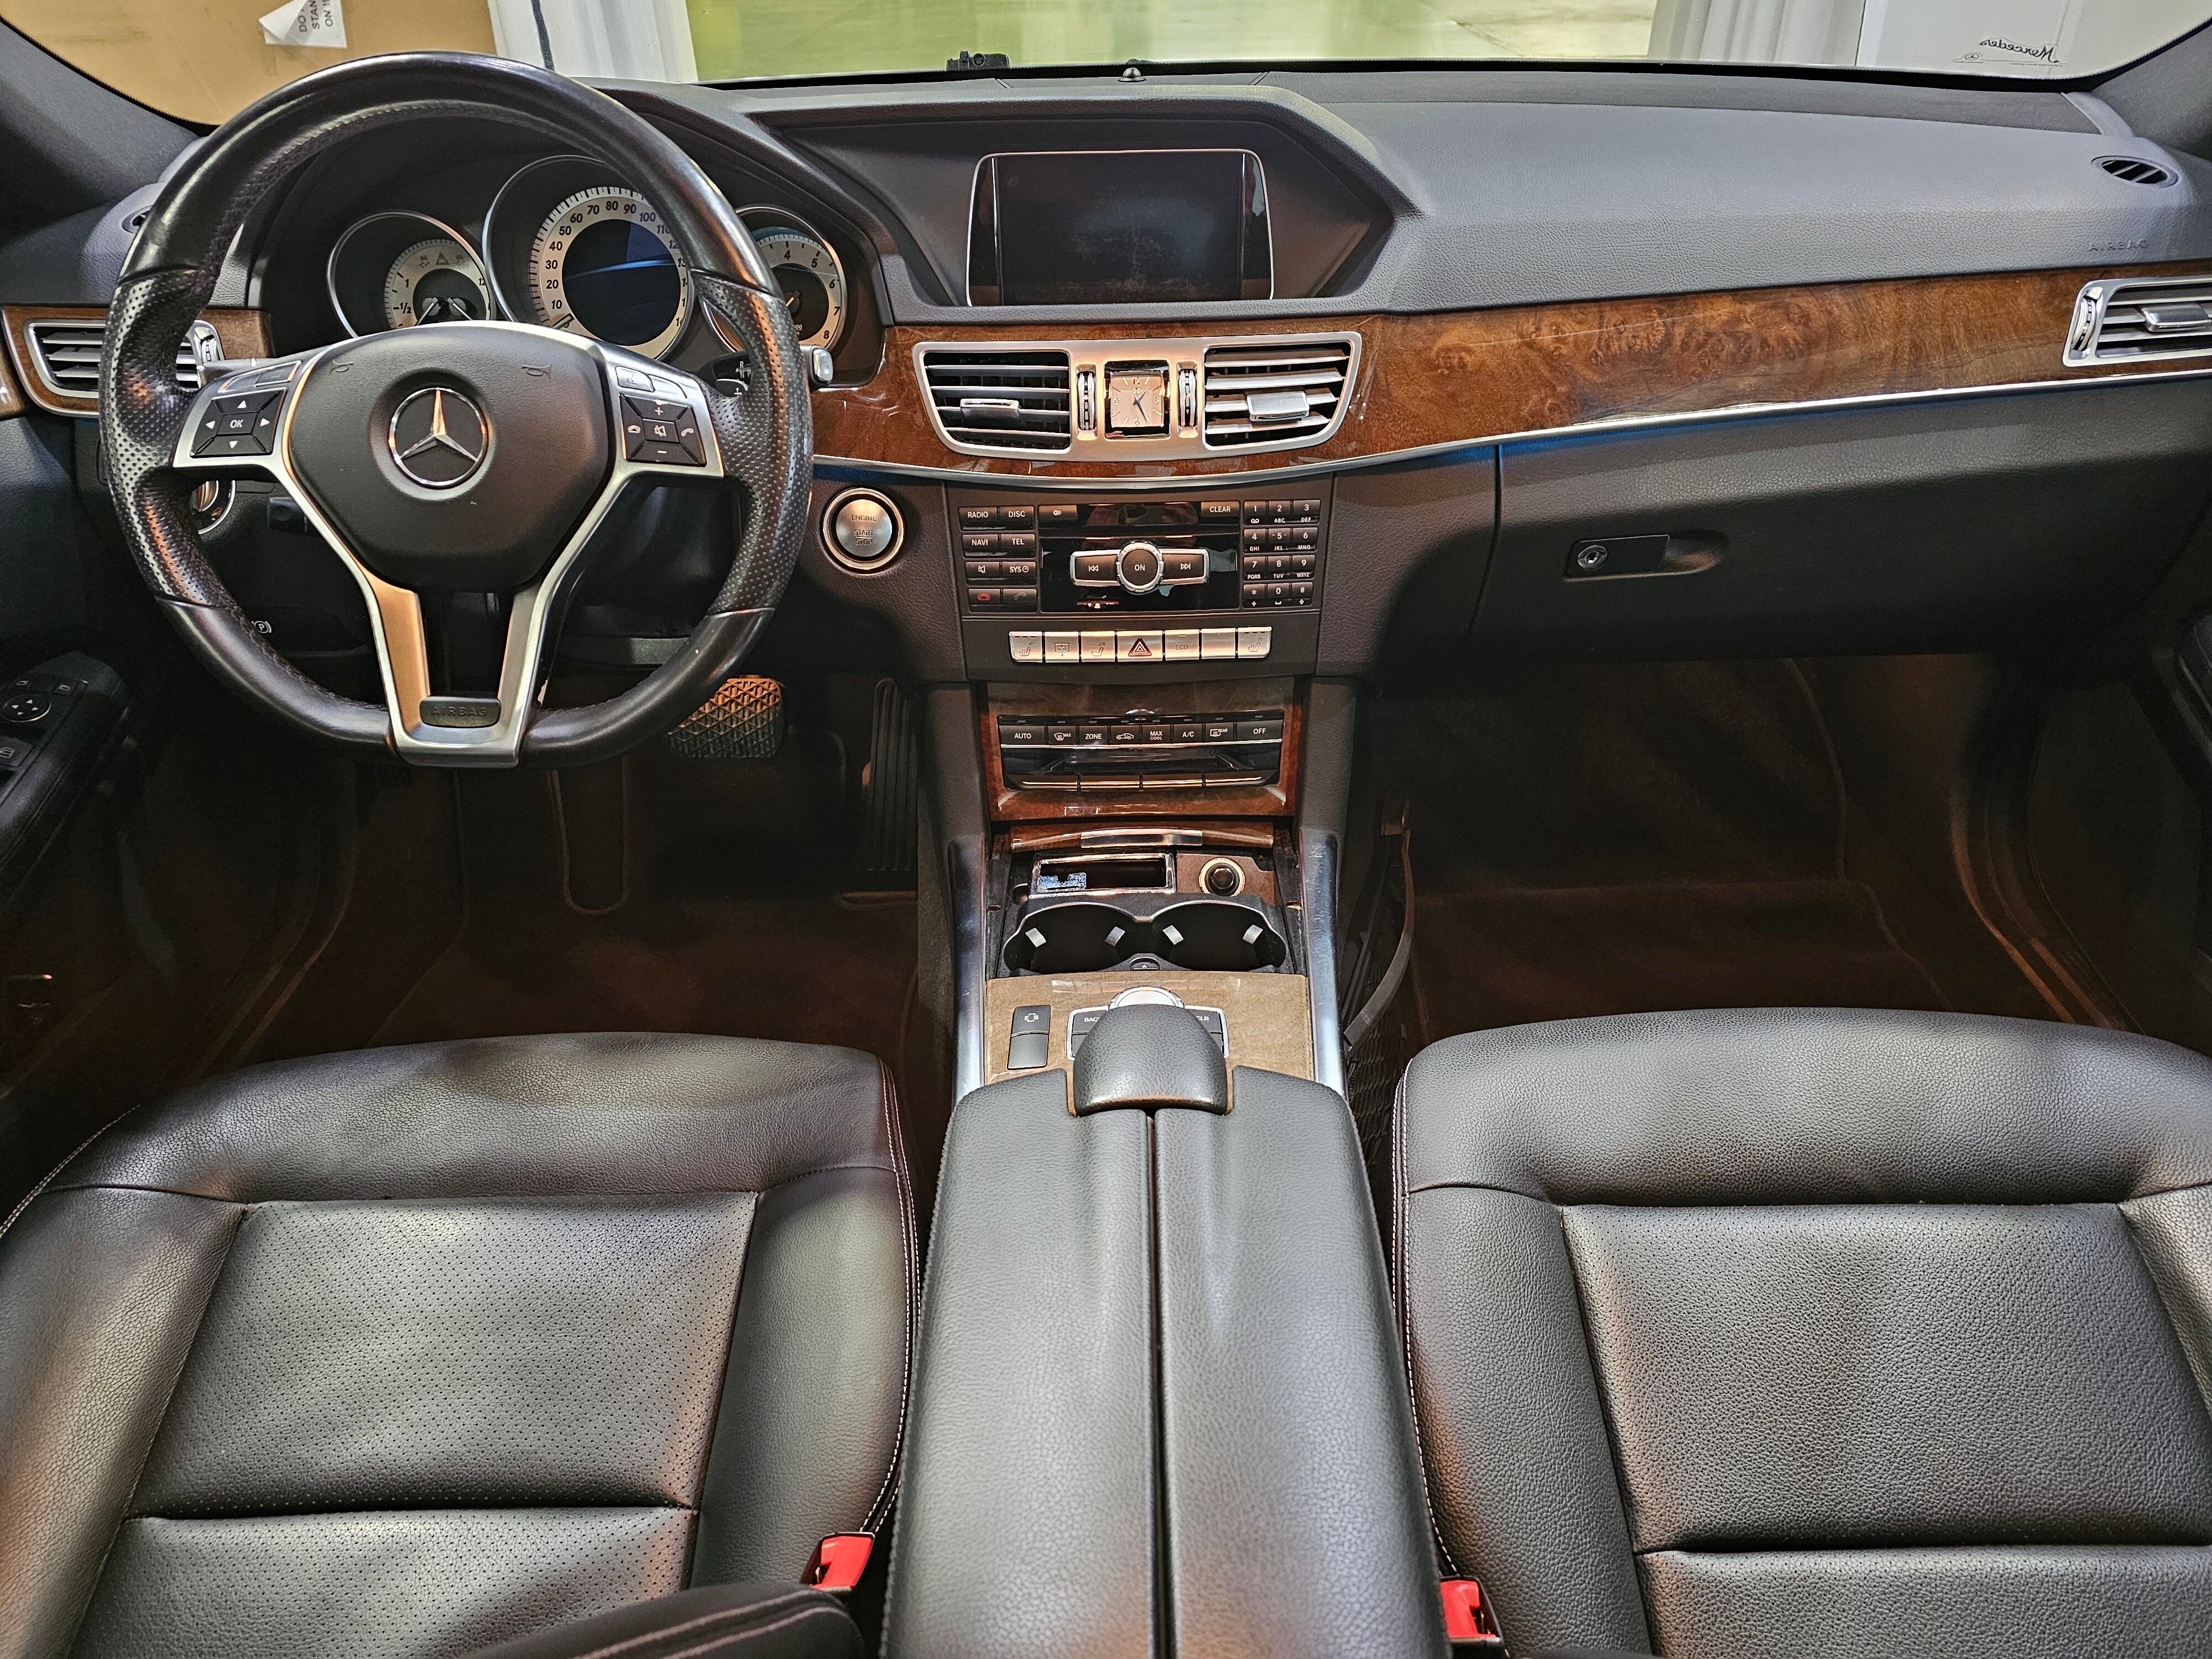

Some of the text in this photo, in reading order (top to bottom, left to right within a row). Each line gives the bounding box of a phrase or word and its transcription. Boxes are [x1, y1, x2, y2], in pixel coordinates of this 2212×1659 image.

[324, 9, 333, 27] ON
[298, 15, 307, 32] DO
[587, 205, 599, 215] 70
[606, 201, 618, 211] 80
[624, 204, 637, 214] 90
[570, 213, 583, 223] 60
[639, 212, 656, 222] 100
[559, 226, 571, 236] 50
[549, 241, 562, 251] 40
[2089, 239, 2149, 252] AIRBAG
[784, 250, 791, 260] 4
[545, 260, 558, 269] 30
[811, 258, 818, 268] 5
[405, 279, 409, 288] 1
[546, 280, 559, 289] 20
[830, 279, 835, 289] 6
[400, 302, 411, 314] 1/2
[551, 300, 562, 310] 10
[834, 306, 840, 316] 7
[823, 330, 830, 339] 8
[739, 361, 744, 369] R
[230, 419, 243, 428] OK
[431, 706, 488, 717] AIRBAG
